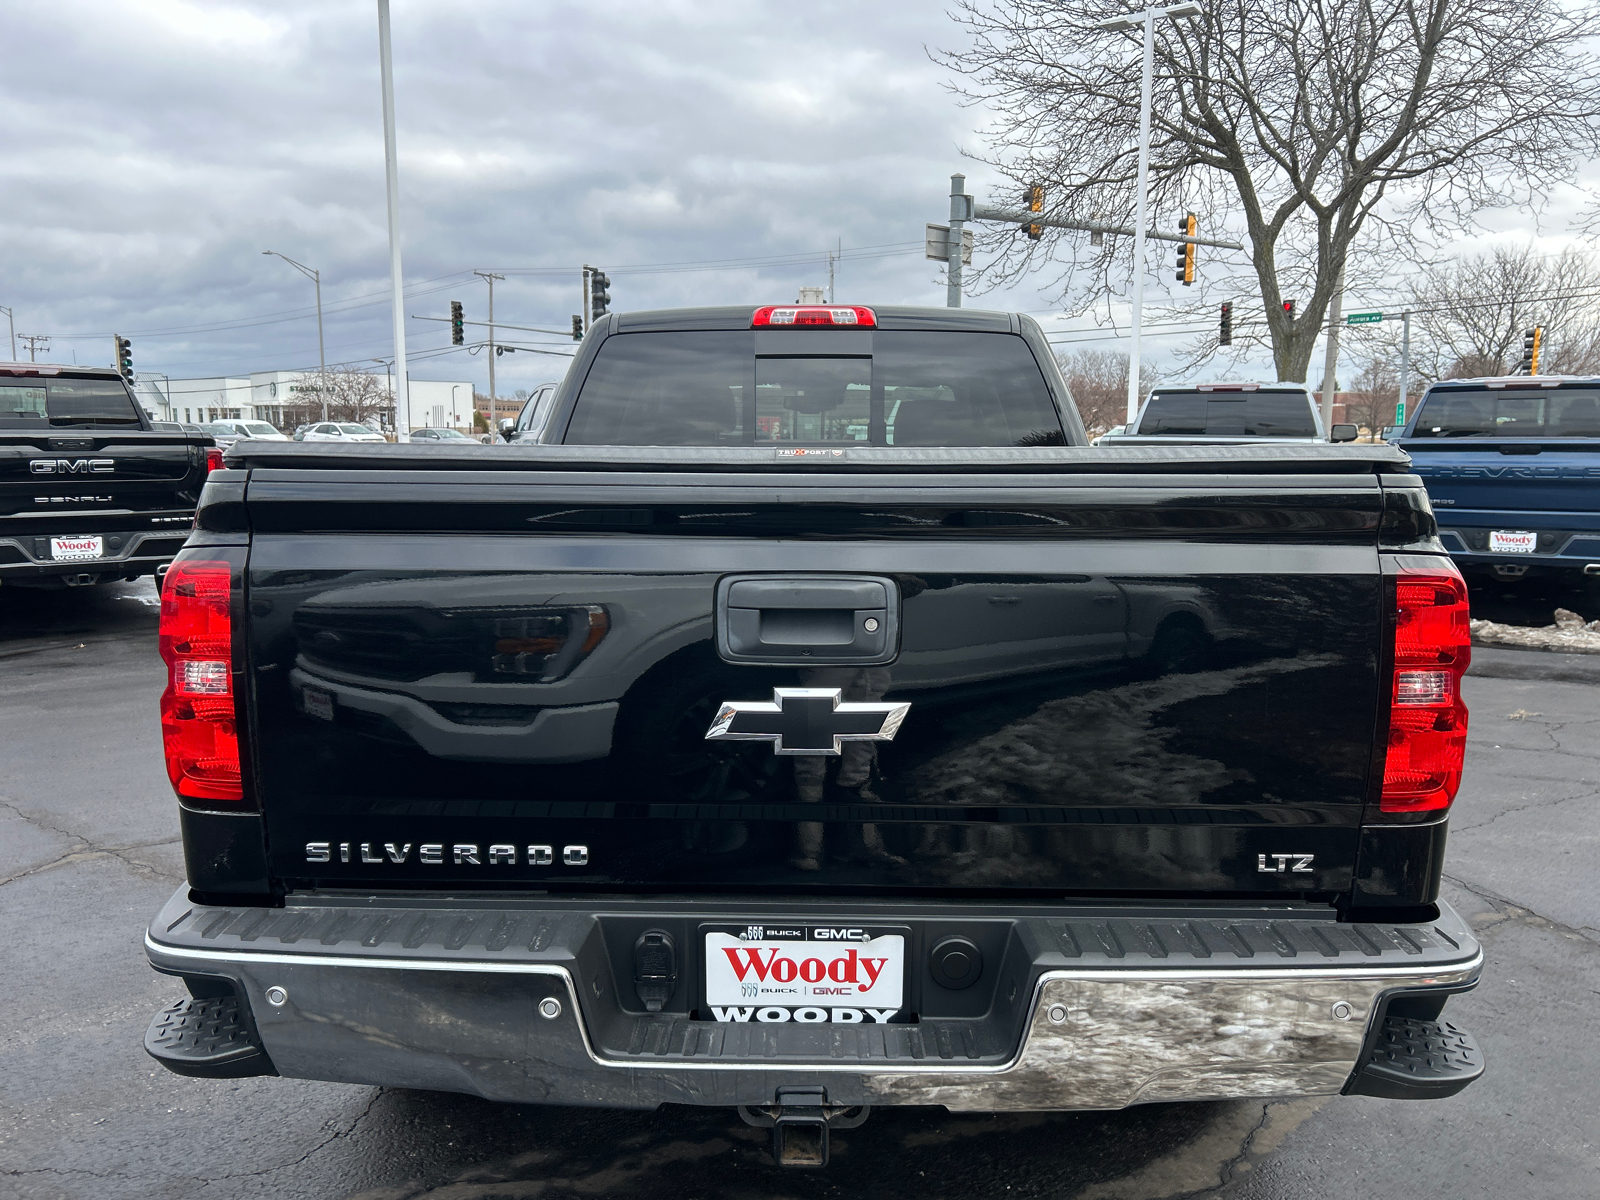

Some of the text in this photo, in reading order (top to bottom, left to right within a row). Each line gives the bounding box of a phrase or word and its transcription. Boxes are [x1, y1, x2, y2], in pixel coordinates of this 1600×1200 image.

[29, 459, 115, 474] GMC
[34, 495, 113, 503] DENALI
[56, 541, 99, 551] Woody
[1495, 534, 1533, 546] Woody
[305, 842, 590, 866] SILVERADO
[1257, 853, 1315, 873] LTZ
[813, 928, 863, 940] GMC
[721, 947, 889, 993] Woody
[812, 986, 852, 996] GMC
[710, 1007, 899, 1024] WOODY
